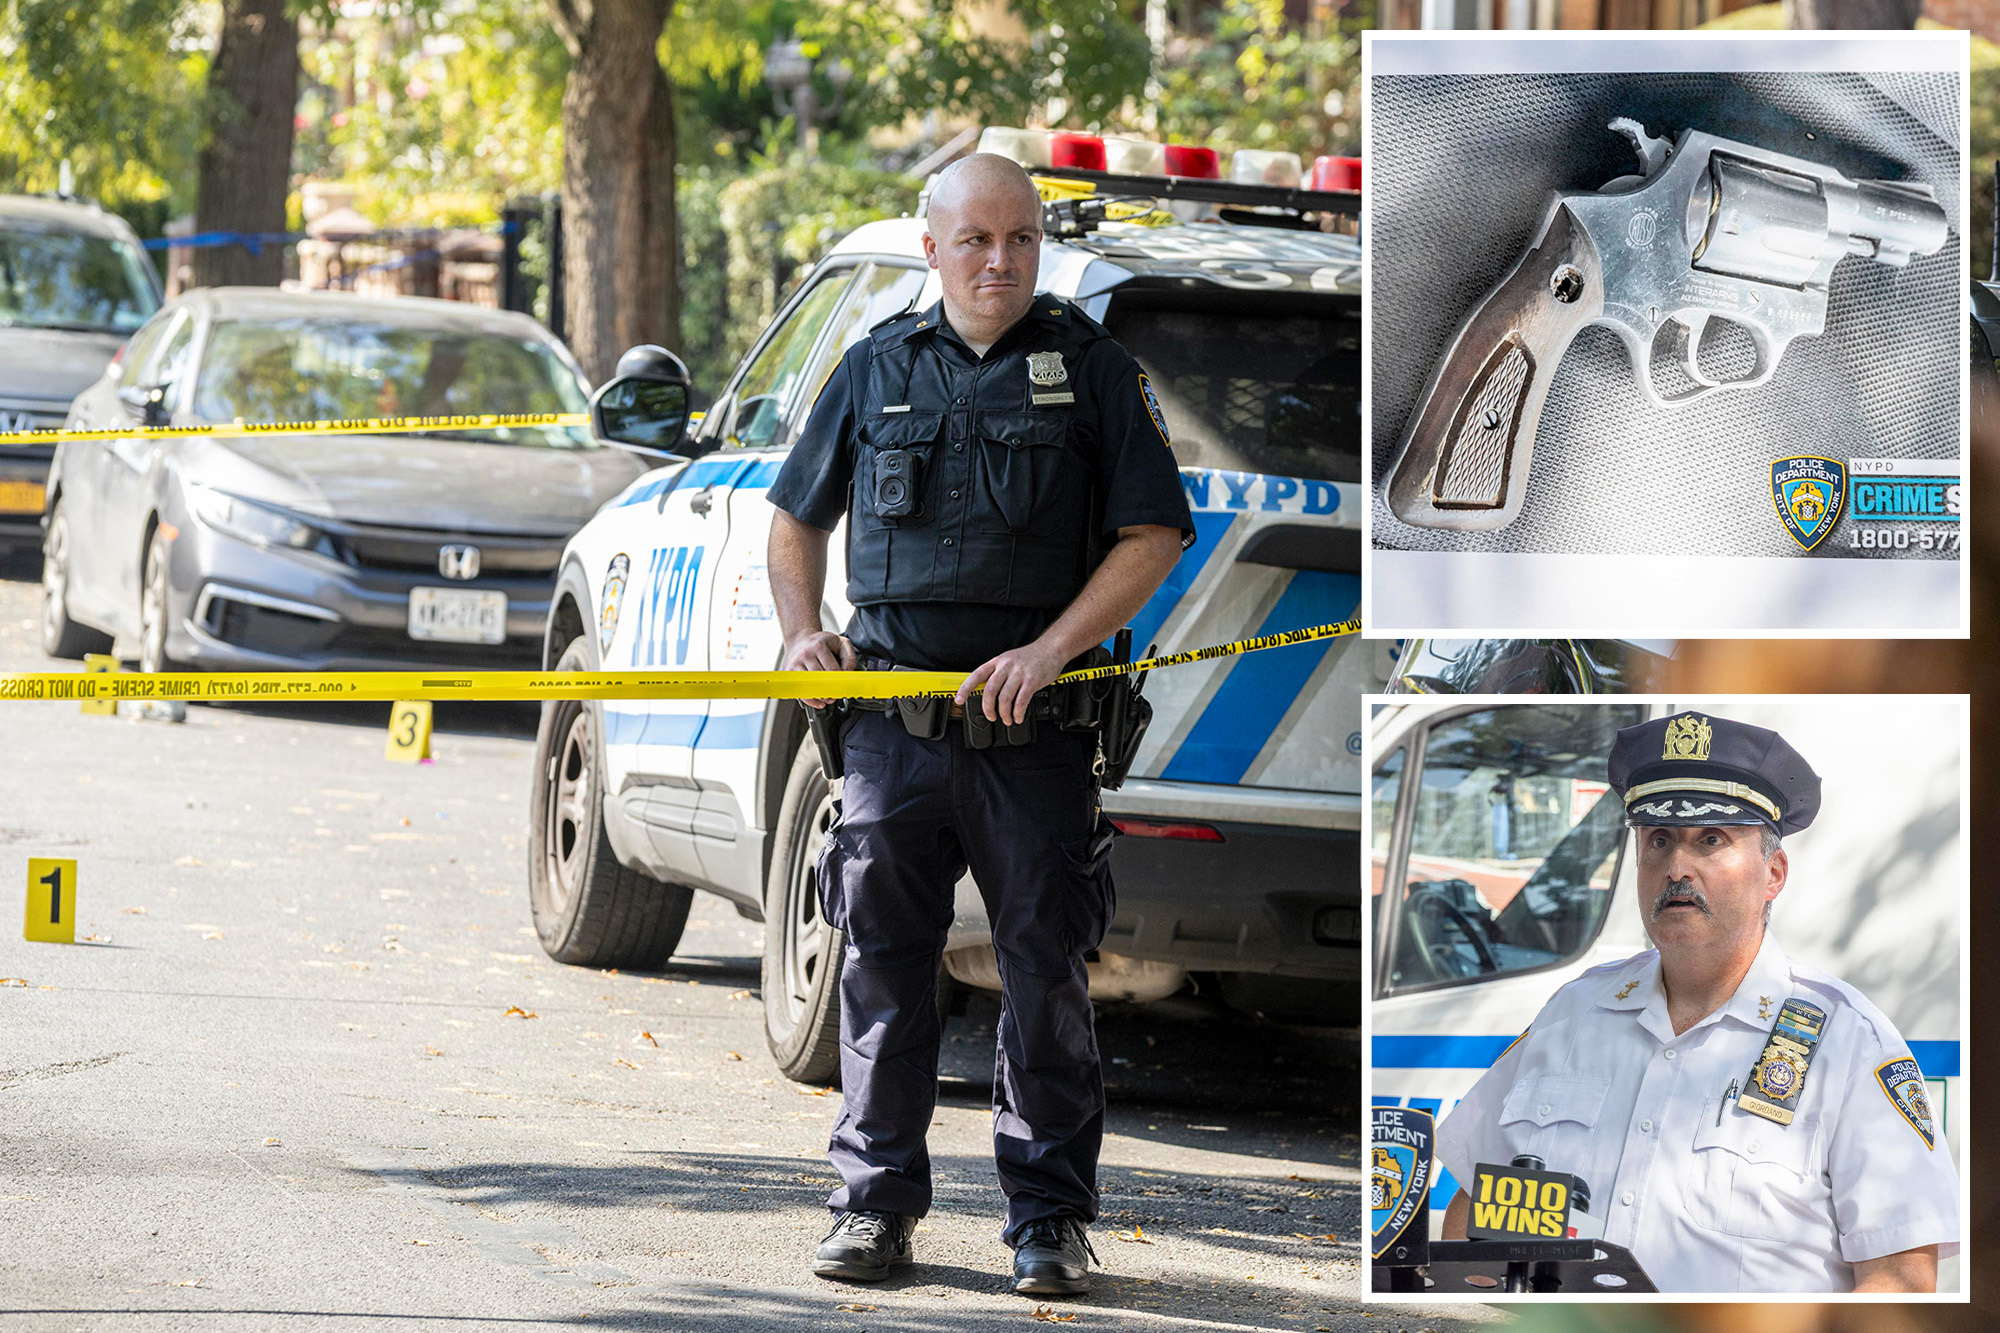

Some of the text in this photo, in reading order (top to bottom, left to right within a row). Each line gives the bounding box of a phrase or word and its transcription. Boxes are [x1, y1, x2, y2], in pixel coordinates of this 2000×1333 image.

[1775, 468, 1840, 485] DEPARTMENT
[1789, 459, 1825, 470] POLICE
[1854, 461, 1894, 472] NYPD
[1180, 468, 1341, 515] NYPD
[1774, 493, 1797, 531] CITY OF
[1817, 490, 1841, 535] NEW YORK
[396, 711, 418, 748] 3
[40, 866, 61, 924] 1
[1890, 1060, 1917, 1074] POLICE
[1749, 1100, 1783, 1119] GIORDANO
[1896, 1097, 1915, 1119] CITY
[1390, 1158, 1429, 1231] NEW YORK
[1479, 1173, 1567, 1212] 1010
[1474, 1202, 1565, 1238] WINS
